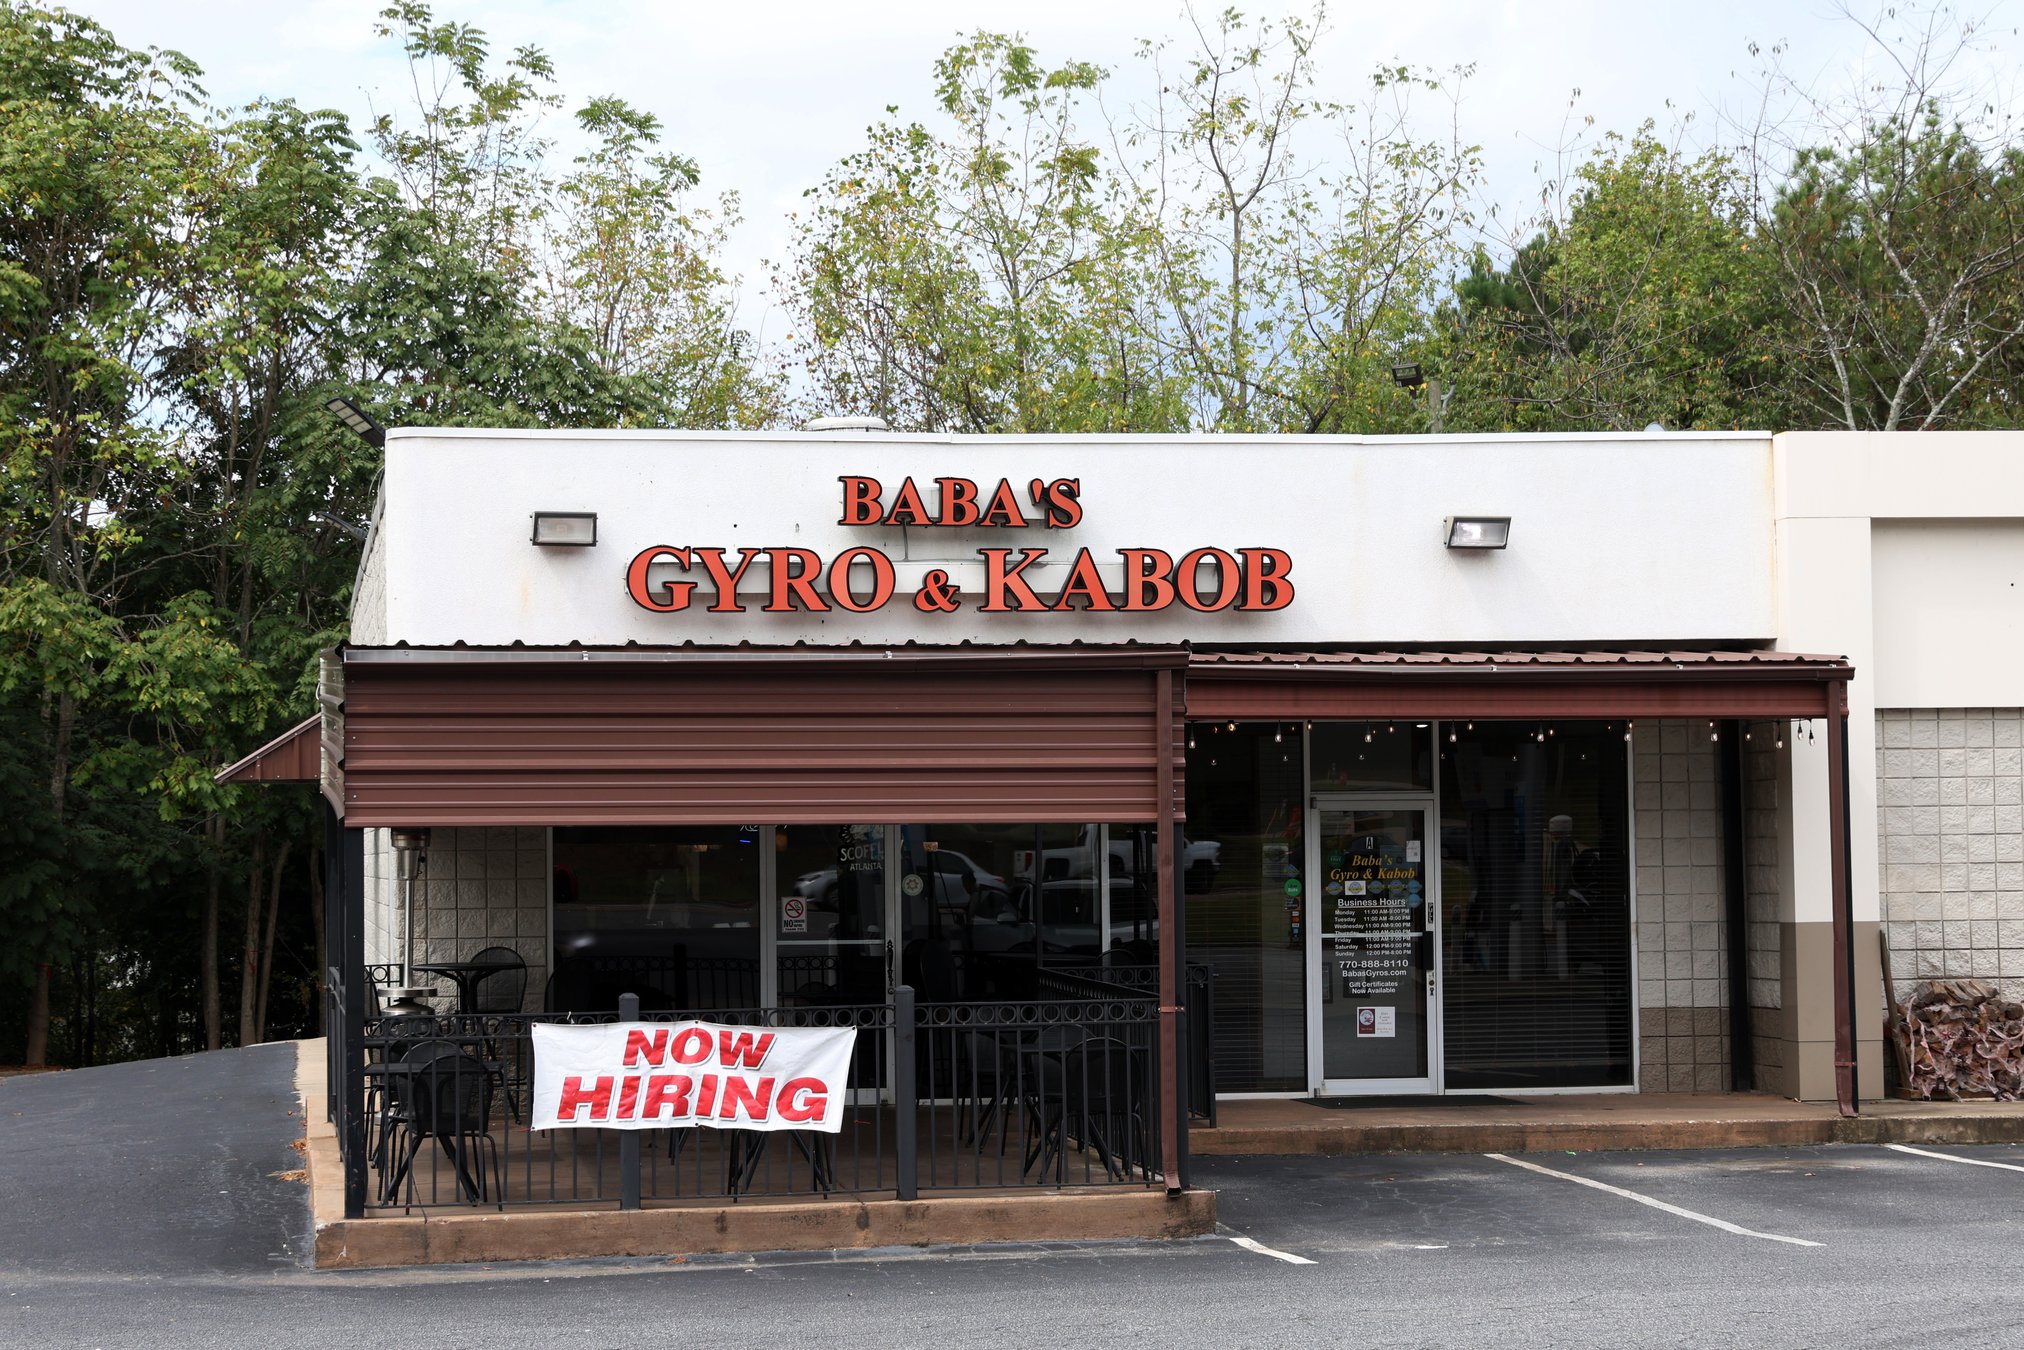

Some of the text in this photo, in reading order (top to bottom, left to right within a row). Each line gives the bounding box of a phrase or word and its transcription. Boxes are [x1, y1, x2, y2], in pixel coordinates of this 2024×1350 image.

[838, 475, 1083, 528] BABA'S
[626, 545, 1295, 613] GYRO & KABOB
[1352, 854, 1393, 867] Baba's
[1330, 868, 1416, 882] Gyro & Kabob
[1338, 897, 1406, 907] Business Hours
[783, 919, 794, 928] NO
[1339, 959, 1409, 969] 770-888-8110
[1342, 969, 1407, 978] BabasGyros.com
[1361, 980, 1398, 988] Certificates
[622, 1027, 778, 1070] NOW
[556, 1074, 831, 1124] HIRING
